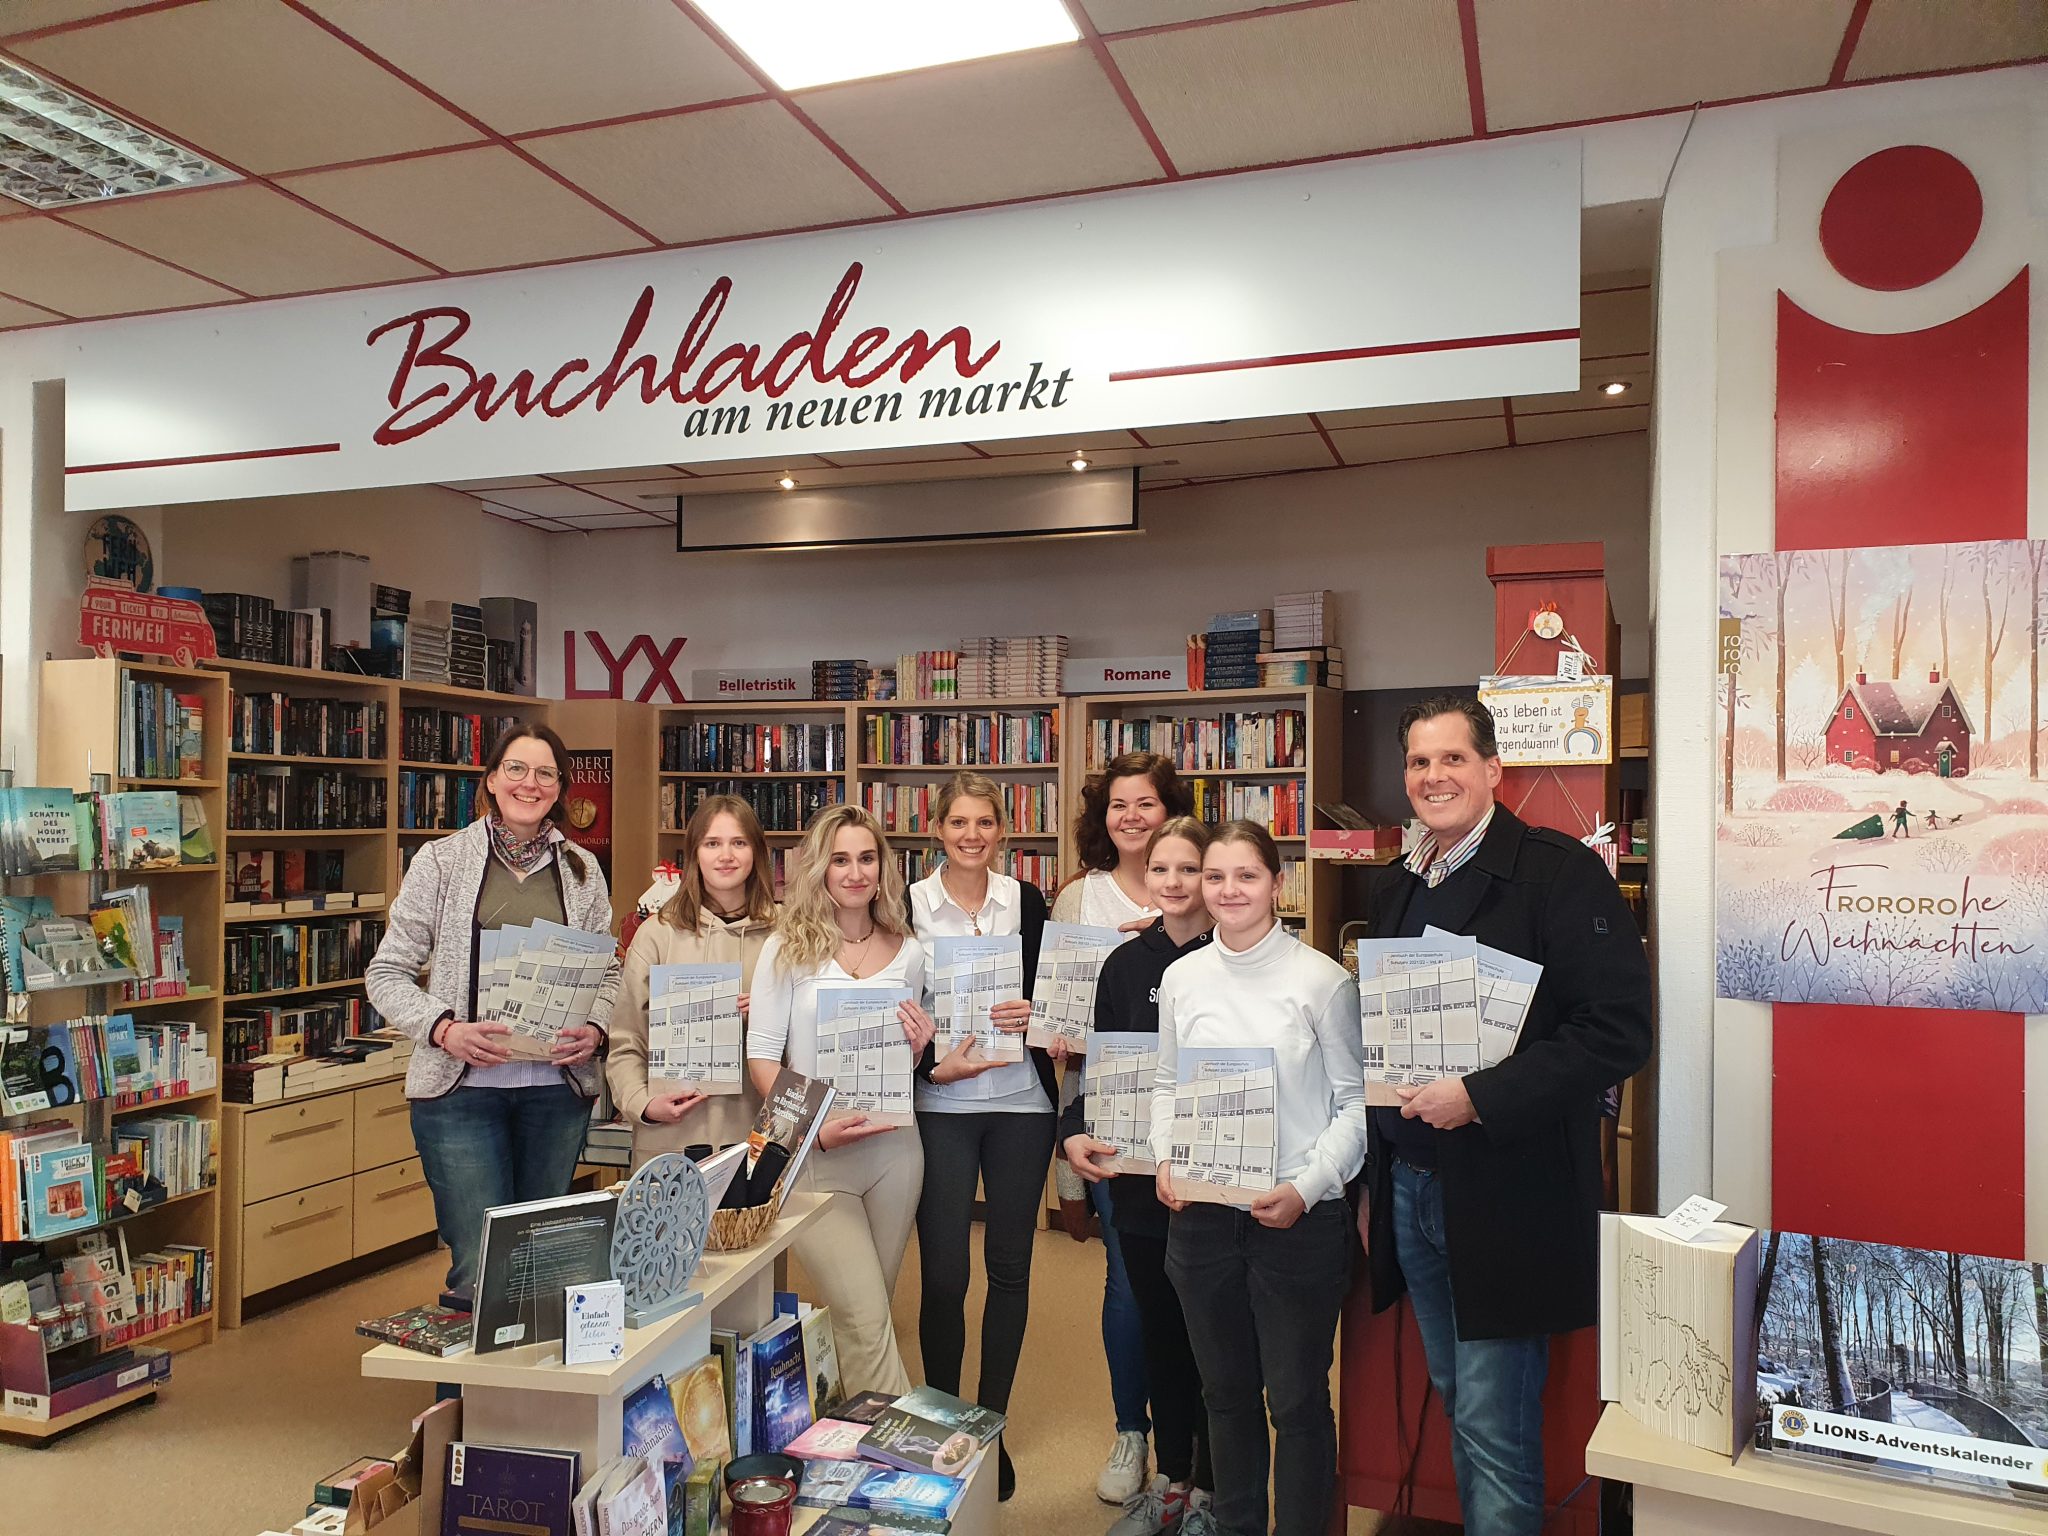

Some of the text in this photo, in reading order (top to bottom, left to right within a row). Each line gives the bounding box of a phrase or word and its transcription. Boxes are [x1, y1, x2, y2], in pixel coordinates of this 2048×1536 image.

[367, 261, 1001, 446] Buchladen
[684, 362, 1073, 438] am neuen markt
[92, 615, 165, 645] FERNWEH
[1723, 635, 1741, 648] ro
[1723, 649, 1741, 661] ro
[564, 630, 688, 703] LYX
[1723, 662, 1741, 674] ro
[1103, 668, 1171, 682] Romane
[718, 678, 796, 692] Belletristik
[1489, 705, 1509, 718] Das
[1550, 706, 1562, 716] ist
[1499, 722, 1553, 734] zu kurz für
[1496, 738, 1559, 753] rgendwann!
[43, 819, 58, 827] DES
[37, 828, 67, 836] MOUNT
[1781, 912, 2035, 966] Weihnachten
[60, 1154, 90, 1168] TRICK 17
[581, 1310, 610, 1320] Einfach
[1813, 1421, 2034, 1471] LIONS-Adventskalender
[453, 1449, 463, 1482] TOPP
[467, 1493, 545, 1522] TAROT
